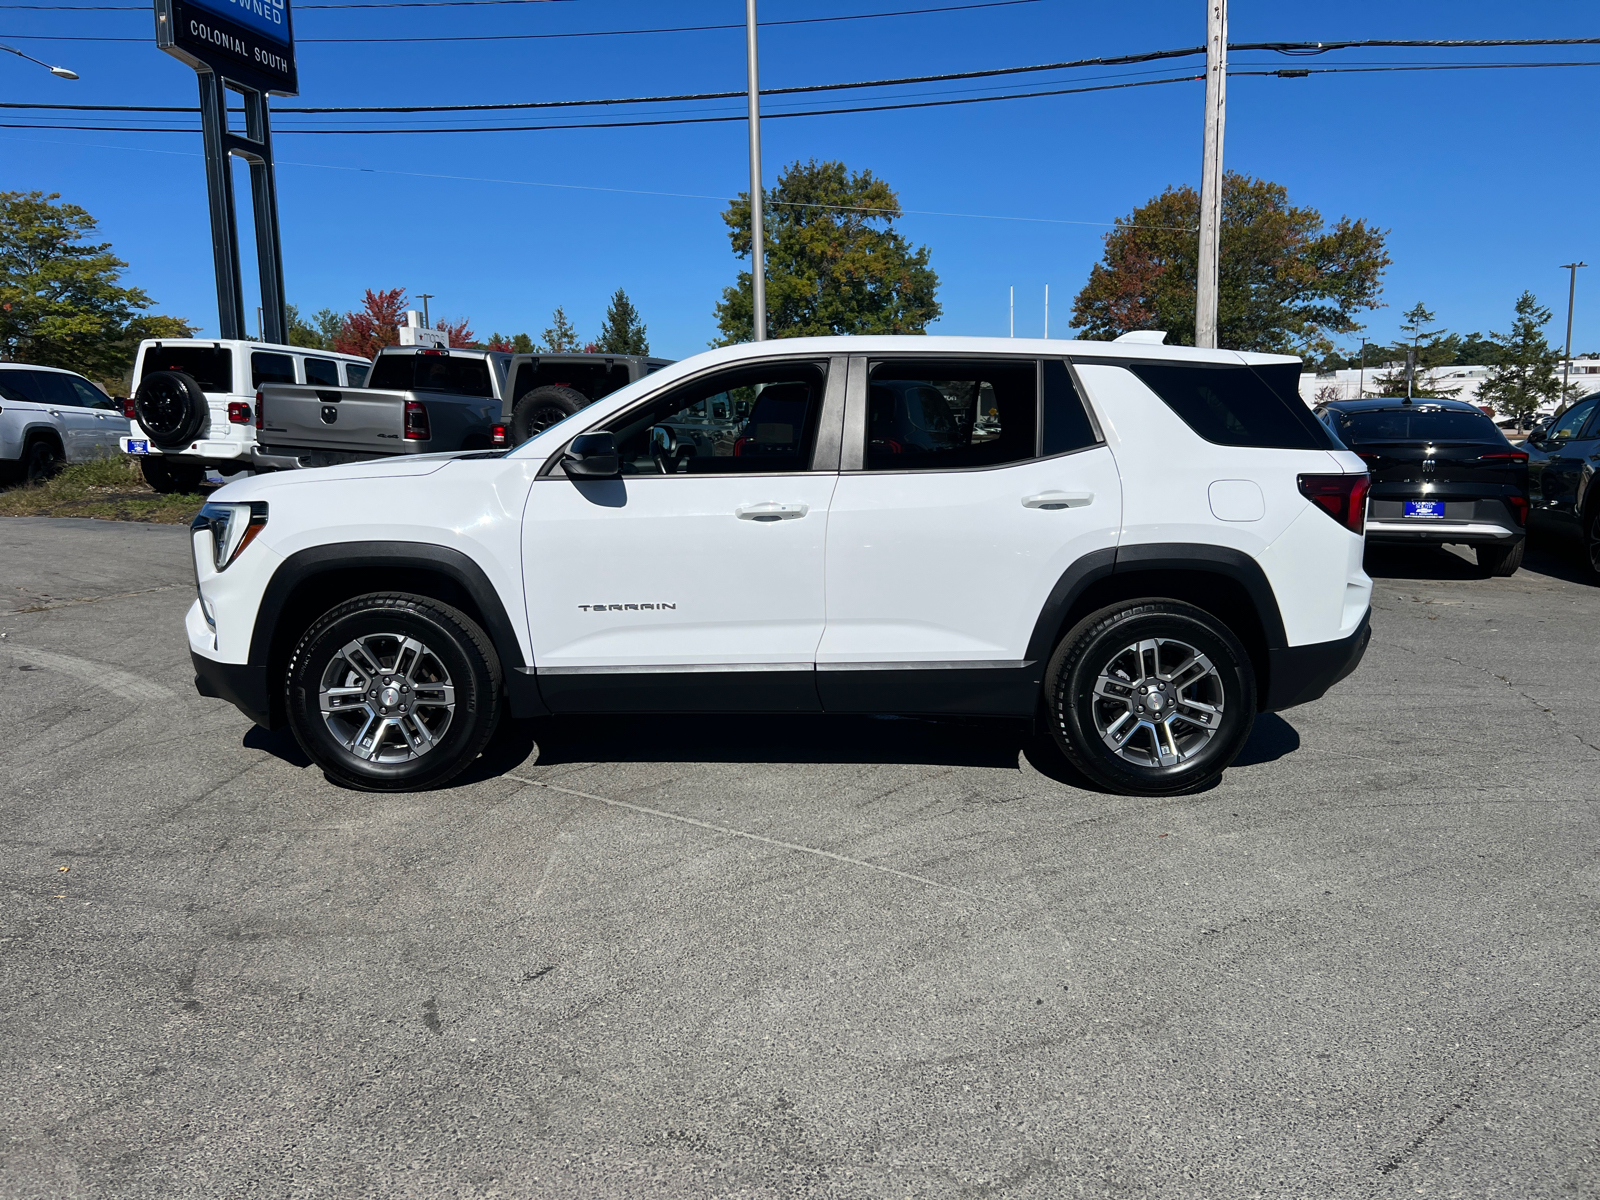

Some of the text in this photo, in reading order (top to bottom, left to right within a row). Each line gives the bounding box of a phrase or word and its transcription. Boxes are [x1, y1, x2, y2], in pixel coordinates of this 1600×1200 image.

[230, 0, 281, 24] WNED
[190, 20, 288, 73] COLONIAL SOUTH
[578, 603, 676, 612] TERRAIN
